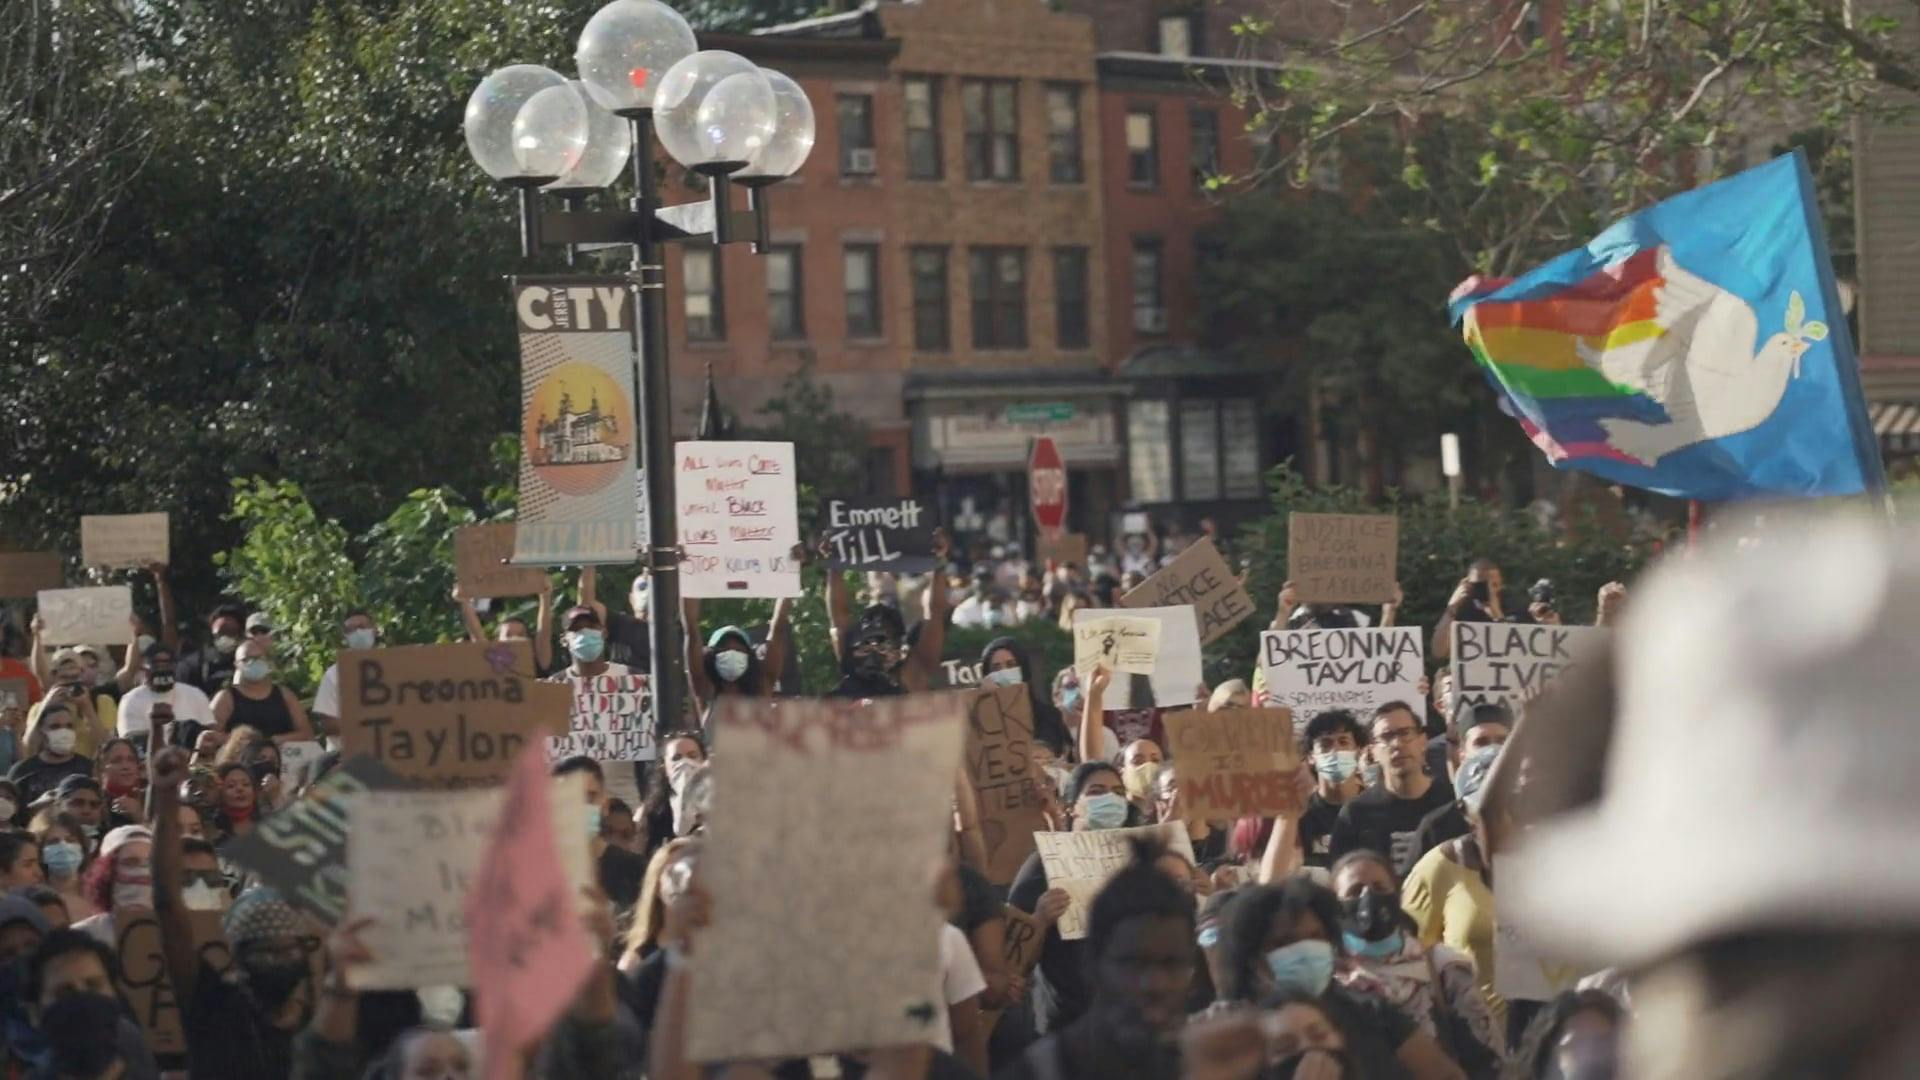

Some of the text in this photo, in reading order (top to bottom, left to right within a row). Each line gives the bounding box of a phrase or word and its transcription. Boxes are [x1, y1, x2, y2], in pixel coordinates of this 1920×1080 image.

[553, 287, 568, 328] JERSEY
[830, 500, 923, 528] Emmett
[1296, 517, 1391, 542] JUSTICE
[1296, 553, 1388, 573] BREONNA
[1308, 575, 1386, 594] TAYLOR
[1266, 630, 1420, 667] BREONNA
[1456, 623, 1570, 662] BLACK
[359, 659, 524, 706] Breonna
[1297, 660, 1410, 687] TAYLOR
[360, 715, 524, 767] Taylor
